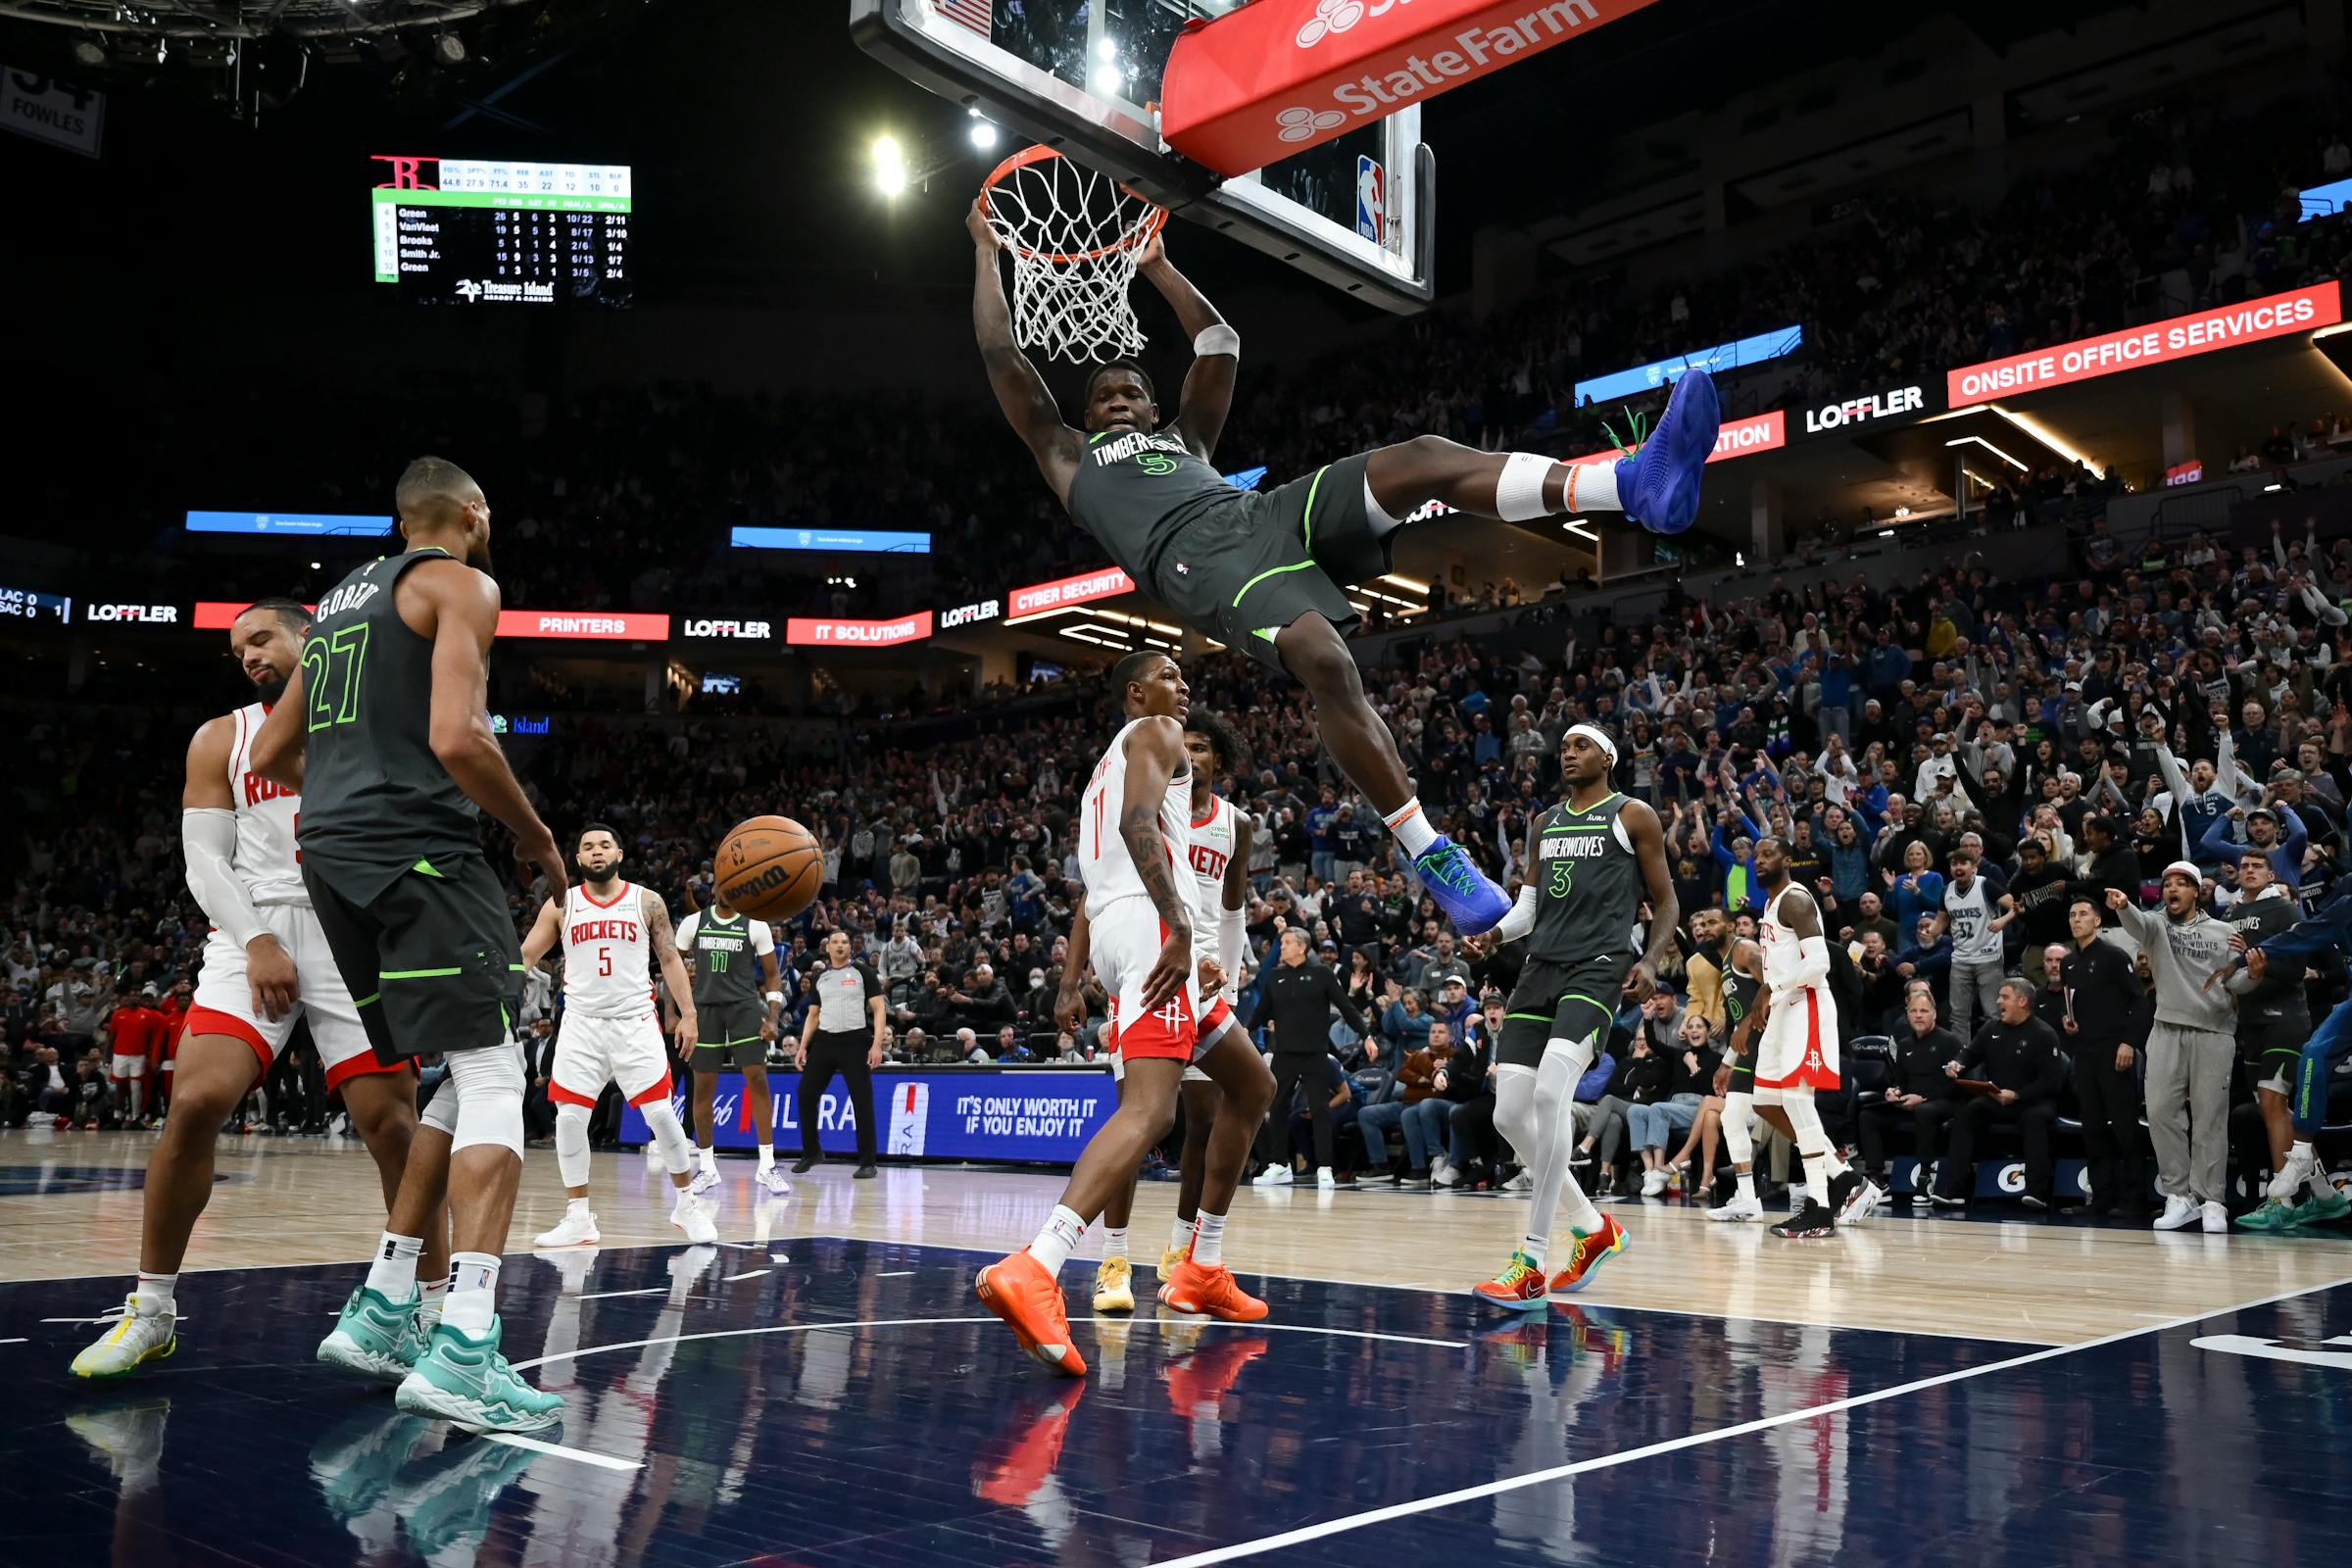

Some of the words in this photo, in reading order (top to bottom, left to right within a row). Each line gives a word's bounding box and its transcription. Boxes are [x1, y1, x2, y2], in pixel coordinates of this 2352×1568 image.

[13, 97, 84, 135] FOWLES
[398, 208, 427, 218] Green
[399, 222, 440, 232] VanVleet
[495, 225, 507, 234] 19
[400, 235, 433, 245] Brooks
[498, 239, 505, 248] 5
[549, 240, 557, 250] 4
[400, 249, 427, 258] Smith
[428, 249, 440, 259] Jr.
[401, 263, 428, 272] Green
[607, 270, 623, 278] 2/4
[481, 279, 522, 295] Treasure
[523, 280, 554, 295] Island
[1961, 357, 2055, 397] ONSITE
[2062, 333, 2160, 373] OFFICE
[2168, 298, 2315, 349] SERVICES
[1806, 386, 1924, 433] LOFFLER
[1136, 453, 1177, 475] 5
[27, 593, 37, 606] 0
[1017, 589, 1060, 611] CYBER
[1062, 572, 1126, 601] SECURITY
[25, 606, 36, 618] 0
[317, 582, 380, 623] GOBERT
[88, 604, 177, 623] LOFFLER
[941, 600, 999, 628] LOFFLER
[539, 617, 625, 634] PRINTERS
[684, 619, 771, 639] LOFFLER
[815, 624, 830, 640] IT
[835, 621, 915, 642] SOLUTIONS
[302, 622, 368, 732] 27
[513, 715, 549, 734] Island
[2206, 803, 2218, 815] 5
[1548, 861, 1575, 898] 3
[1951, 907, 1982, 919] WOLVES
[571, 920, 638, 947] ROCKETS
[1958, 921, 1974, 938] 32
[699, 937, 744, 953] TIMBERWOLVES
[599, 947, 612, 977] 5
[710, 951, 728, 973] 11
[956, 1095, 982, 1115] IT'S
[984, 1098, 1021, 1116] ONLY
[1023, 1099, 1079, 1117] WORTH
[1082, 1099, 1098, 1117] IT
[965, 1116, 980, 1134] IF
[983, 1116, 1012, 1135] YOU
[1015, 1117, 1065, 1136] ENJOY
[1068, 1118, 1084, 1137] IT
